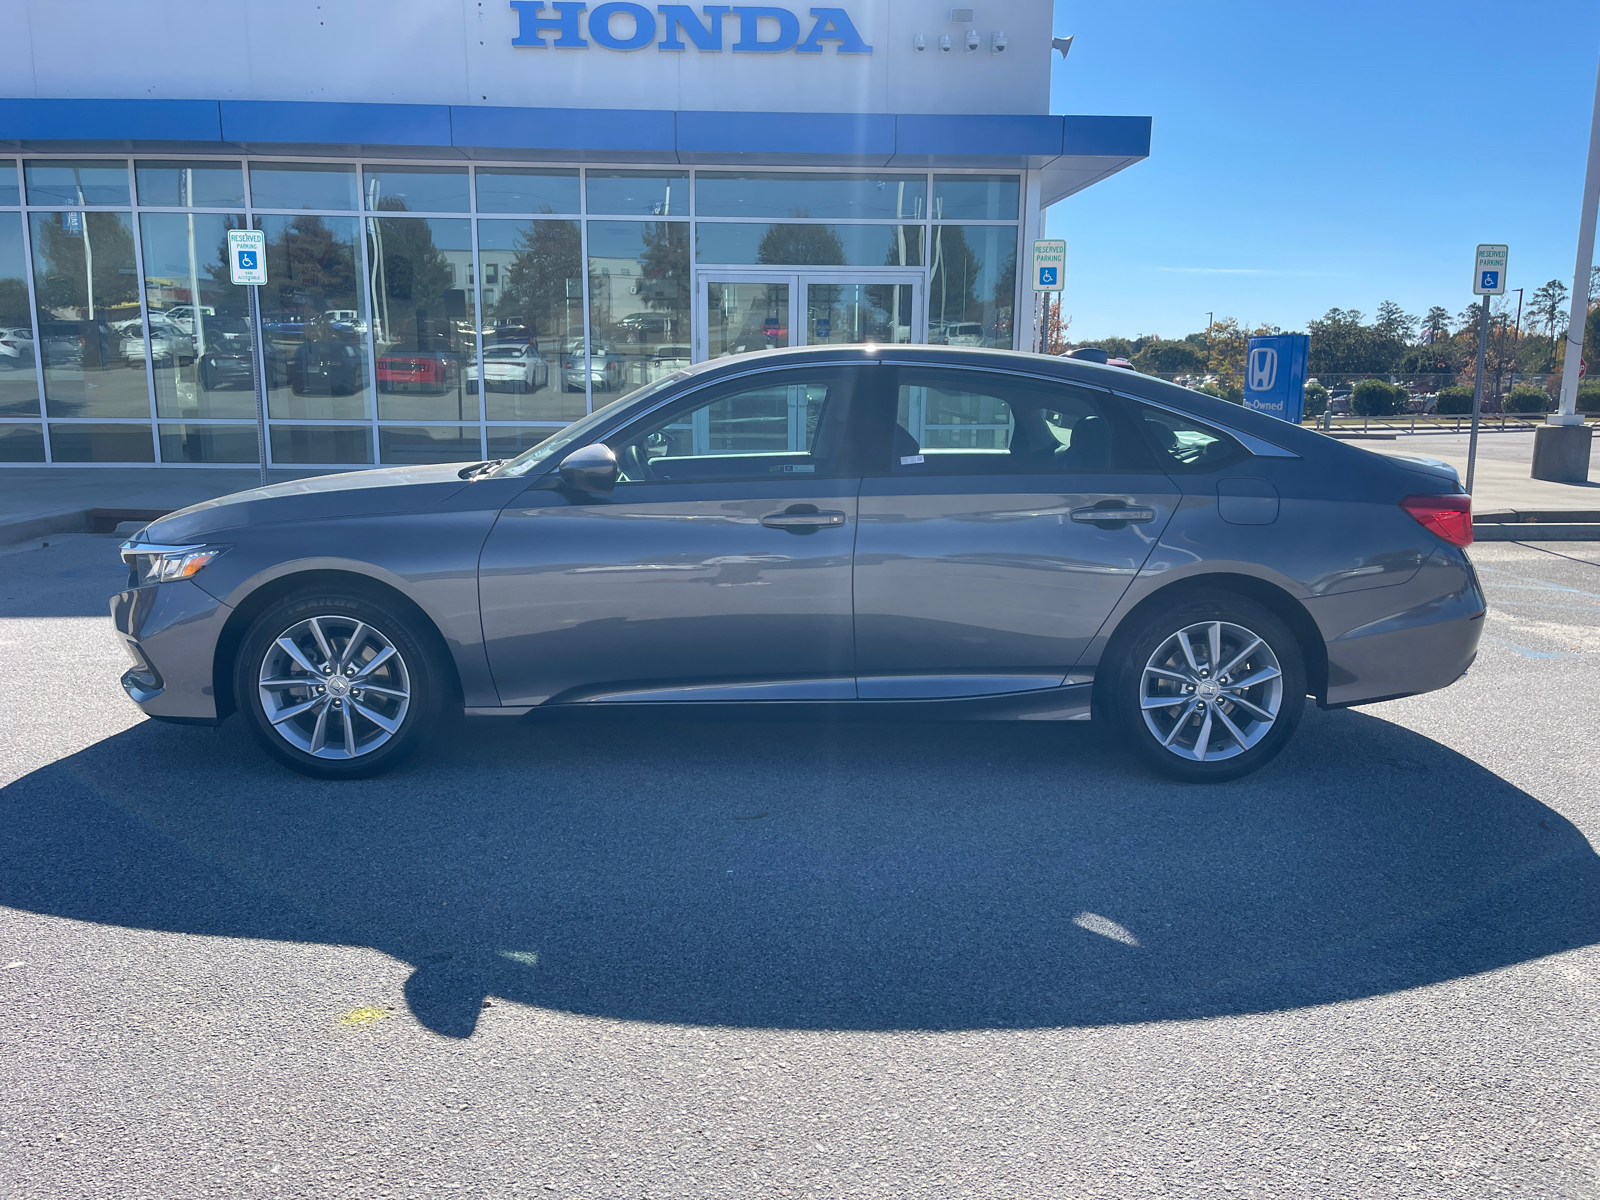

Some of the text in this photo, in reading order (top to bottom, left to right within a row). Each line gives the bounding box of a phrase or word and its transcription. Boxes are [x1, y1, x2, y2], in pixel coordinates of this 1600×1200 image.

[509, 0, 873, 55] HONDA
[231, 234, 262, 243] RESERVED
[1035, 245, 1064, 253] RESERVED
[1036, 254, 1062, 262] PARKING
[1478, 250, 1506, 258] RESERVED
[1479, 259, 1504, 267] PARKING
